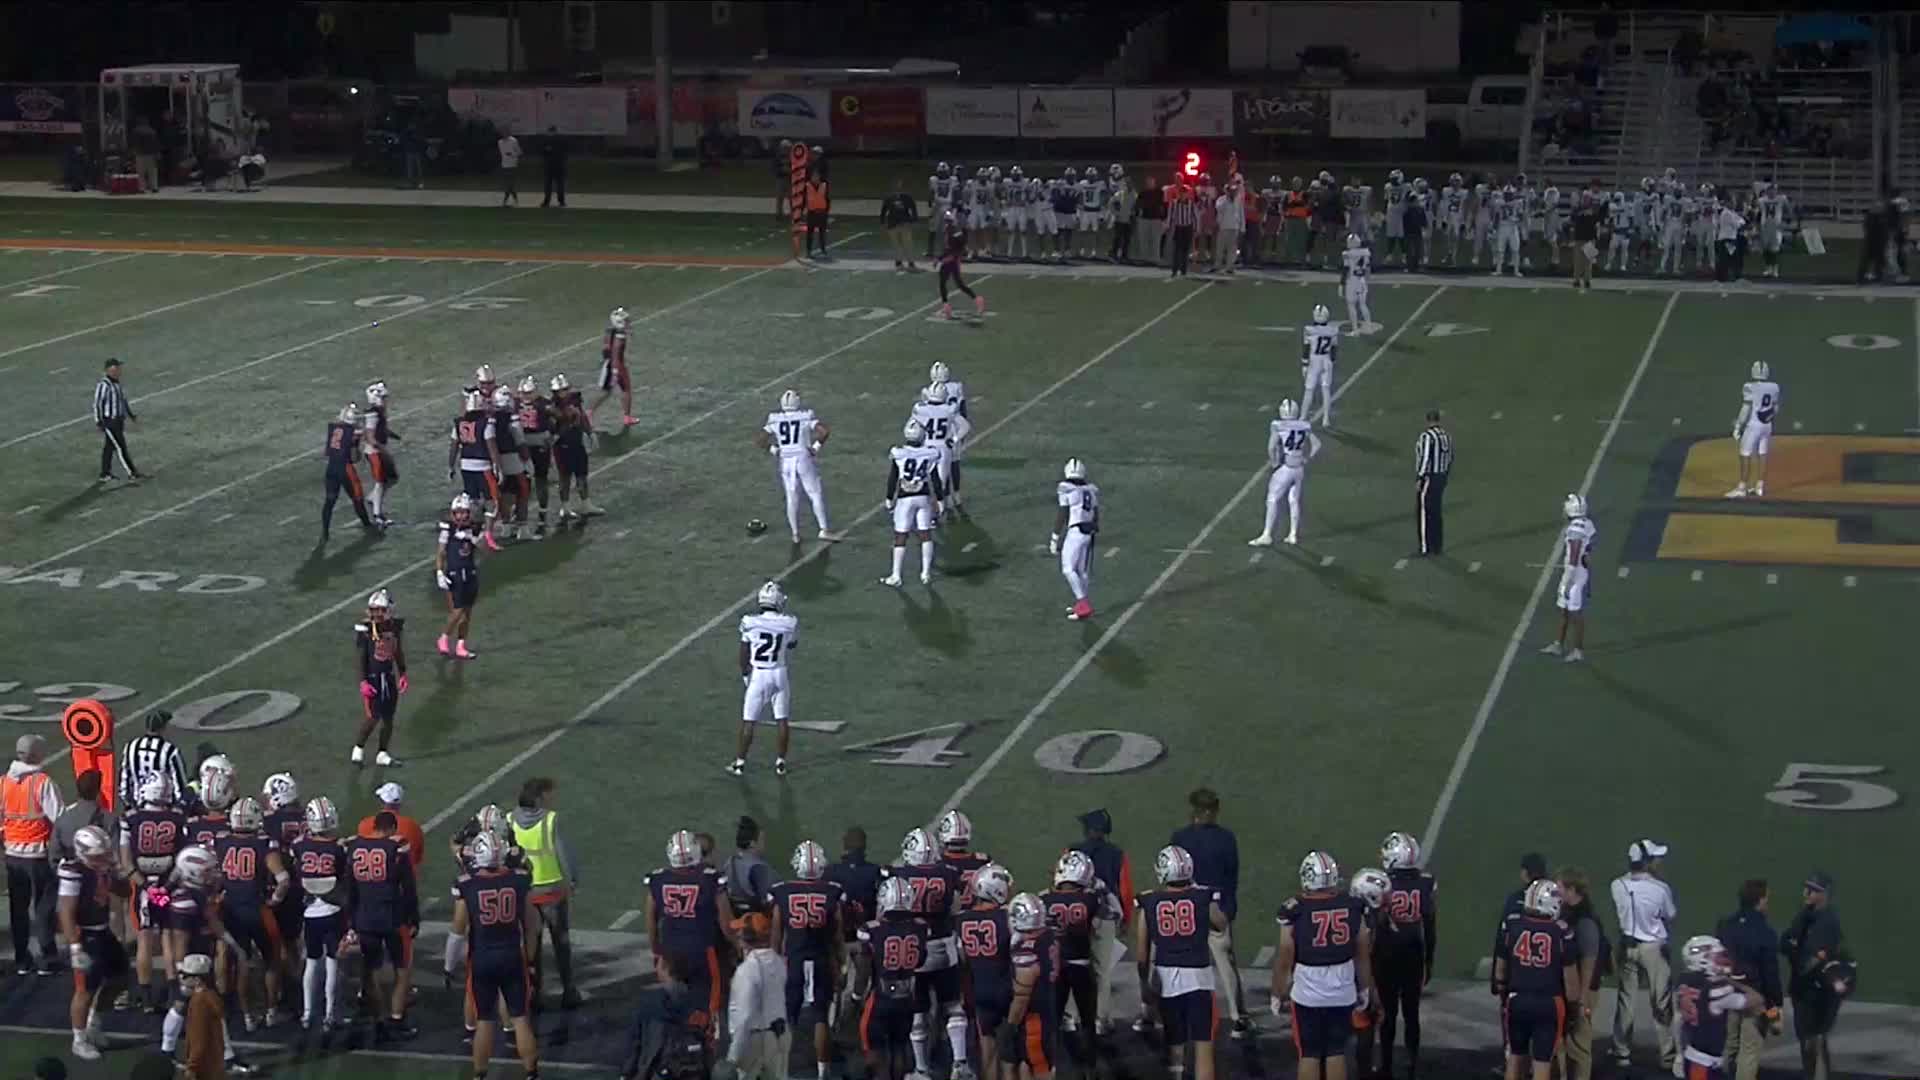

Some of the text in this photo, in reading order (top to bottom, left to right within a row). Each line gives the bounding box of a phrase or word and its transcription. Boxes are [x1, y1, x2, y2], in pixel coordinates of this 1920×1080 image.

[1184, 151, 1201, 176] 2
[1315, 337, 1331, 355] 12
[1825, 335, 1902, 351] 0
[779, 421, 801, 445] 97
[925, 418, 948, 440] 45
[904, 459, 929, 481] 94
[754, 631, 783, 661] 21
[168, 689, 305, 731] 0
[842, 722, 1168, 775] 4 0
[1765, 762, 1898, 811] 5
[139, 820, 176, 854] 82
[222, 846, 256, 880] 40
[352, 848, 387, 882] 28
[478, 886, 517, 926] 50
[662, 884, 700, 919] 57
[788, 892, 827, 929] 55
[909, 876, 946, 913] 72
[1391, 888, 1423, 924] 21
[1155, 899, 1195, 936] 68
[1311, 908, 1350, 947] 75
[882, 935, 920, 971] 86
[961, 919, 998, 957] 53
[1512, 929, 1552, 967] 43
